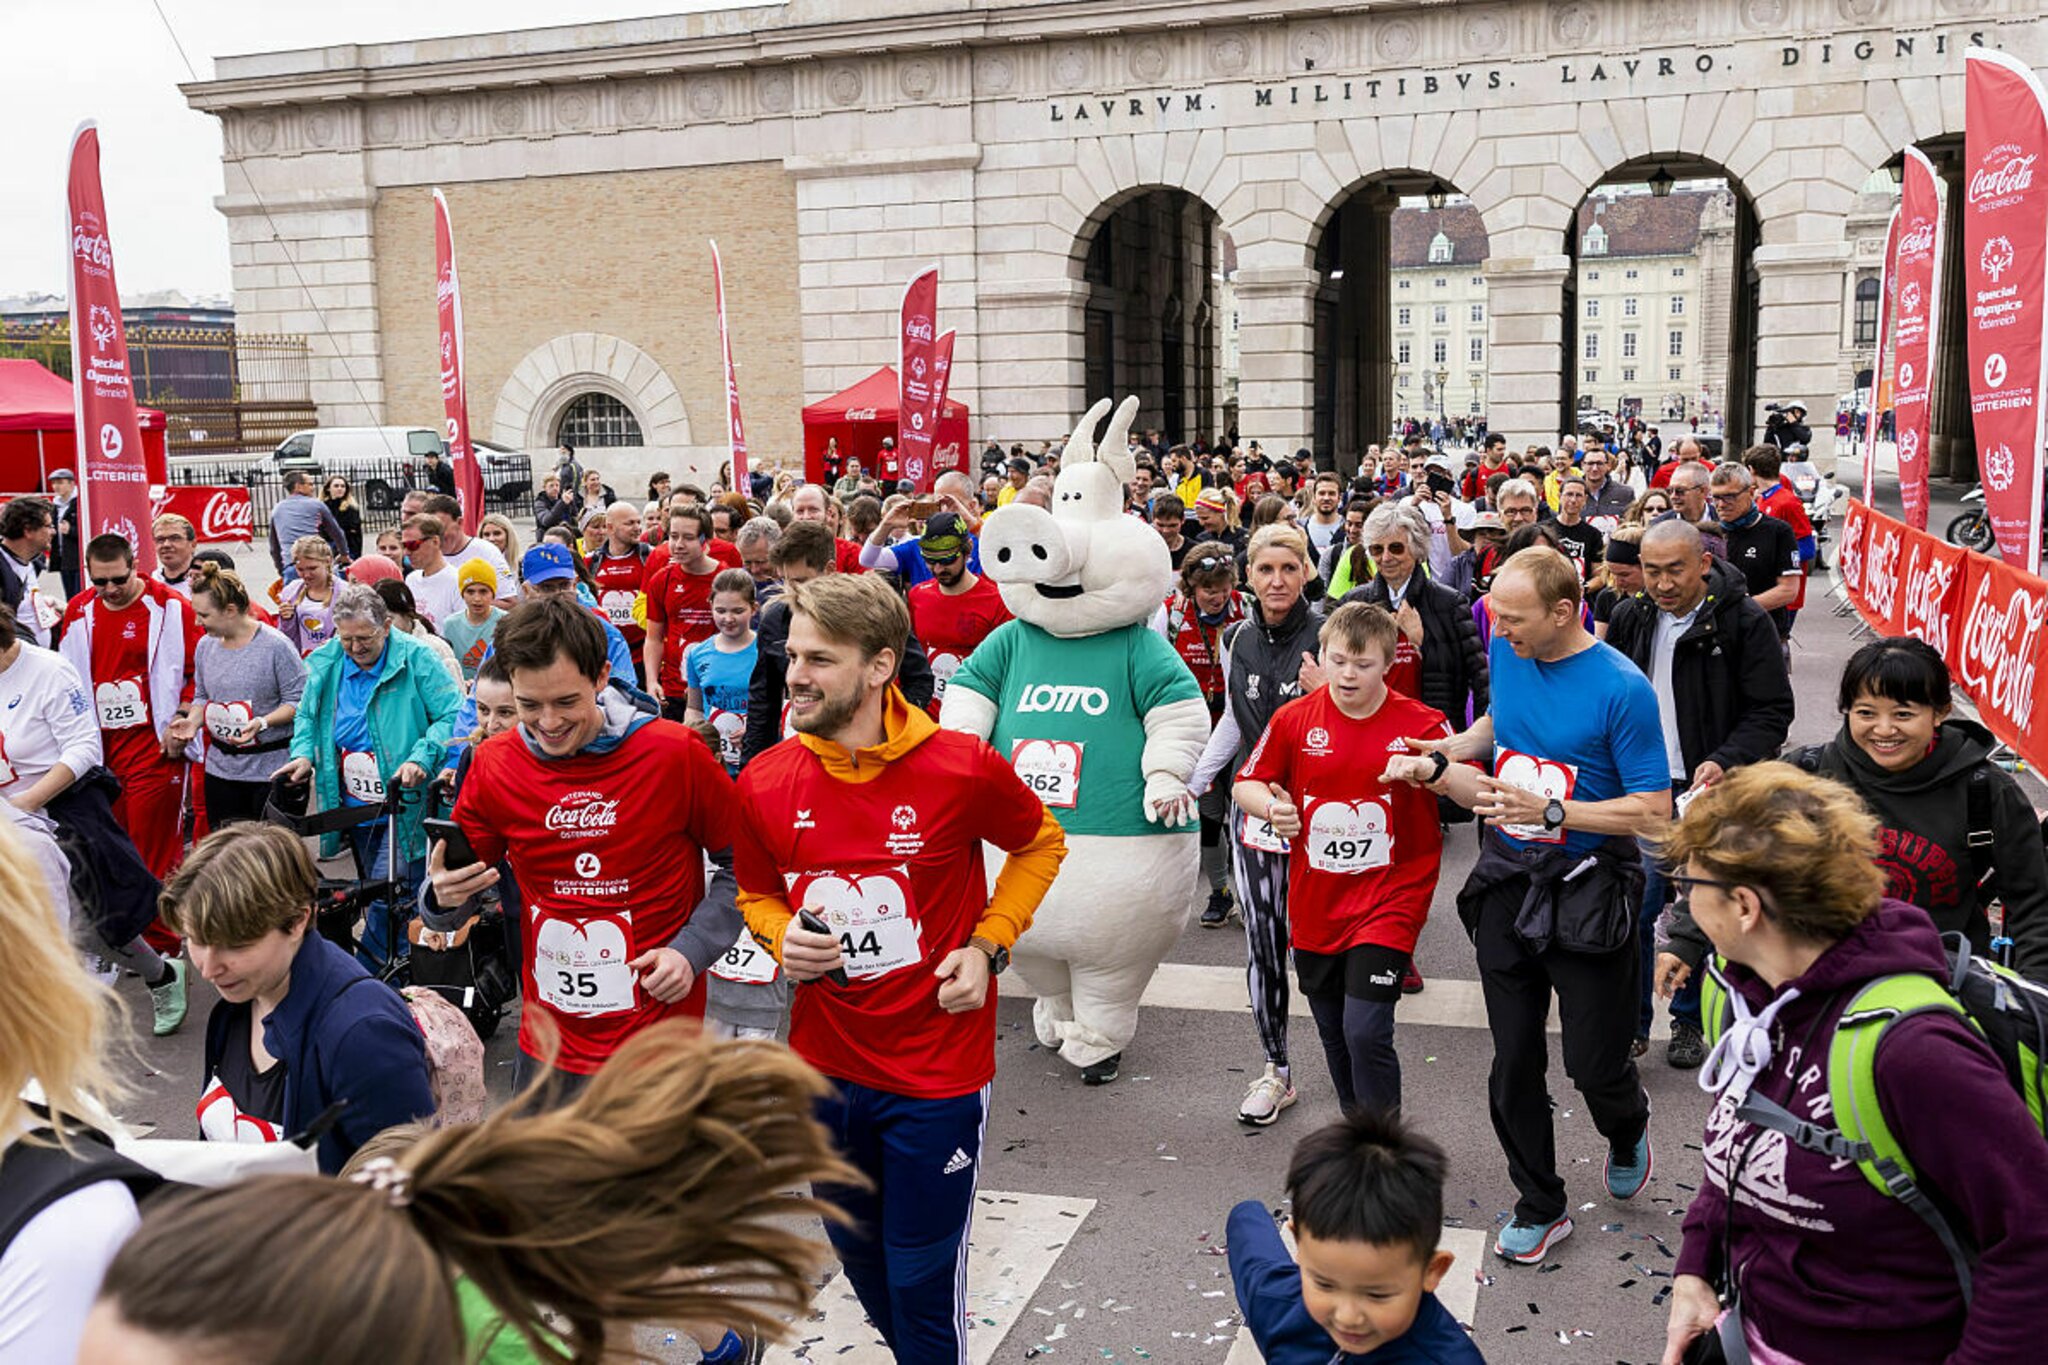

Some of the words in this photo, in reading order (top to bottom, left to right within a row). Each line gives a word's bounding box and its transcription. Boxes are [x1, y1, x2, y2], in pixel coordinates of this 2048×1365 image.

[1969, 154, 2039, 203] Coca-Cola
[1977, 284, 2018, 303] Special
[1973, 300, 2023, 318] Olympics
[1972, 396, 2033, 413] LOTTERIEN
[1961, 571, 2045, 738] Coca-Cola
[1015, 684, 1110, 716] LOTTO
[104, 704, 135, 721] 225
[352, 777, 385, 795] 318
[1022, 773, 1062, 793] 362
[545, 800, 620, 831] Coca-Cola
[1323, 838, 1373, 860] 497
[554, 885, 629, 896] LOTTERIEN
[725, 947, 756, 968] 87
[557, 970, 599, 998] 35
